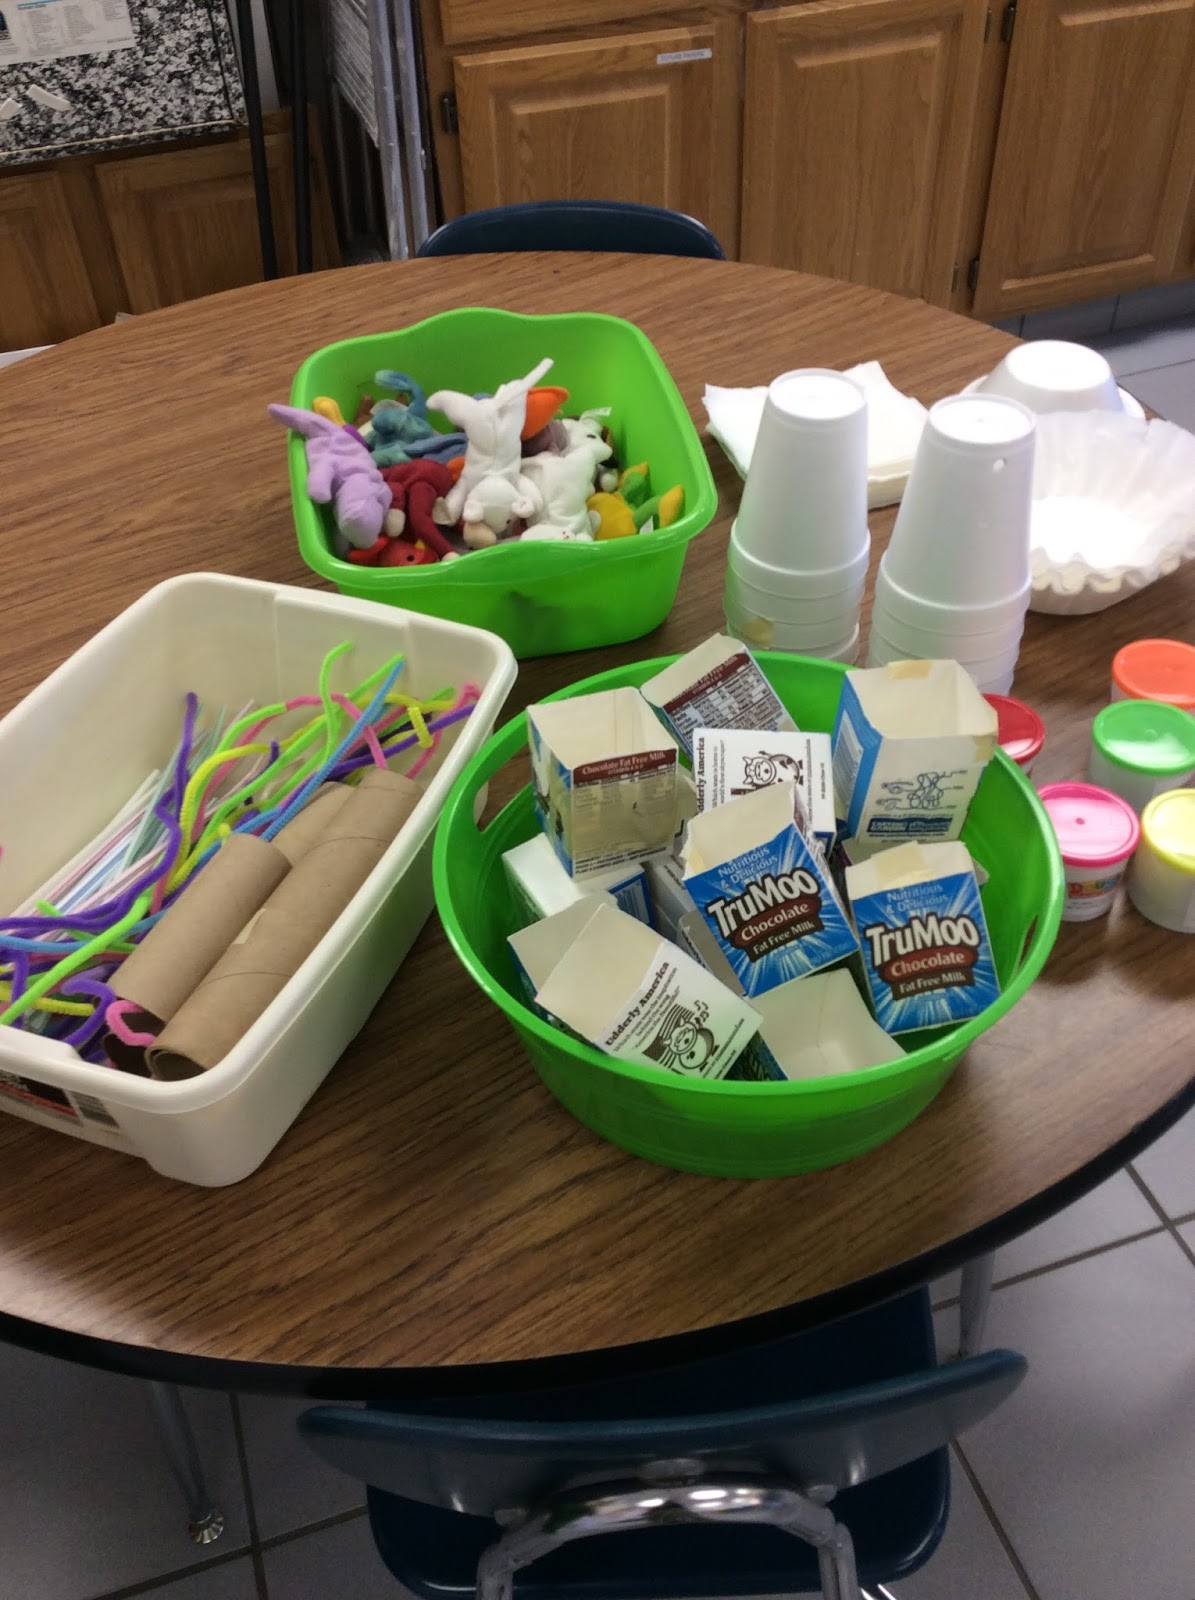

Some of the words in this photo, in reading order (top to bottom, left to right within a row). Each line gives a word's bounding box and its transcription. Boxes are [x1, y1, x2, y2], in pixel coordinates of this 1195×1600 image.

[580, 759, 619, 775] Chocolate
[618, 757, 631, 767] Fat
[631, 754, 648, 764] Free
[648, 750, 666, 761] Milk
[696, 737, 705, 776] America
[695, 777, 706, 812] dderly
[717, 845, 771, 878] Nutritious
[718, 878, 730, 890] &
[729, 852, 779, 884] Delicious
[706, 869, 816, 937] TruMoo
[885, 881, 943, 903] Nutritious
[885, 903, 894, 914] &
[896, 891, 949, 912] Delicious
[738, 902, 810, 942] Chocolate
[752, 940, 769, 955] Fat
[767, 927, 792, 946] Free
[790, 919, 815, 936] Milk
[864, 914, 978, 967] TruMoo
[889, 951, 965, 977] Chocolate
[898, 980, 916, 994] Fat
[915, 973, 941, 989] Free
[941, 970, 966, 982] Milk
[604, 1003, 642, 1049] Udderly
[640, 964, 670, 1007] America
